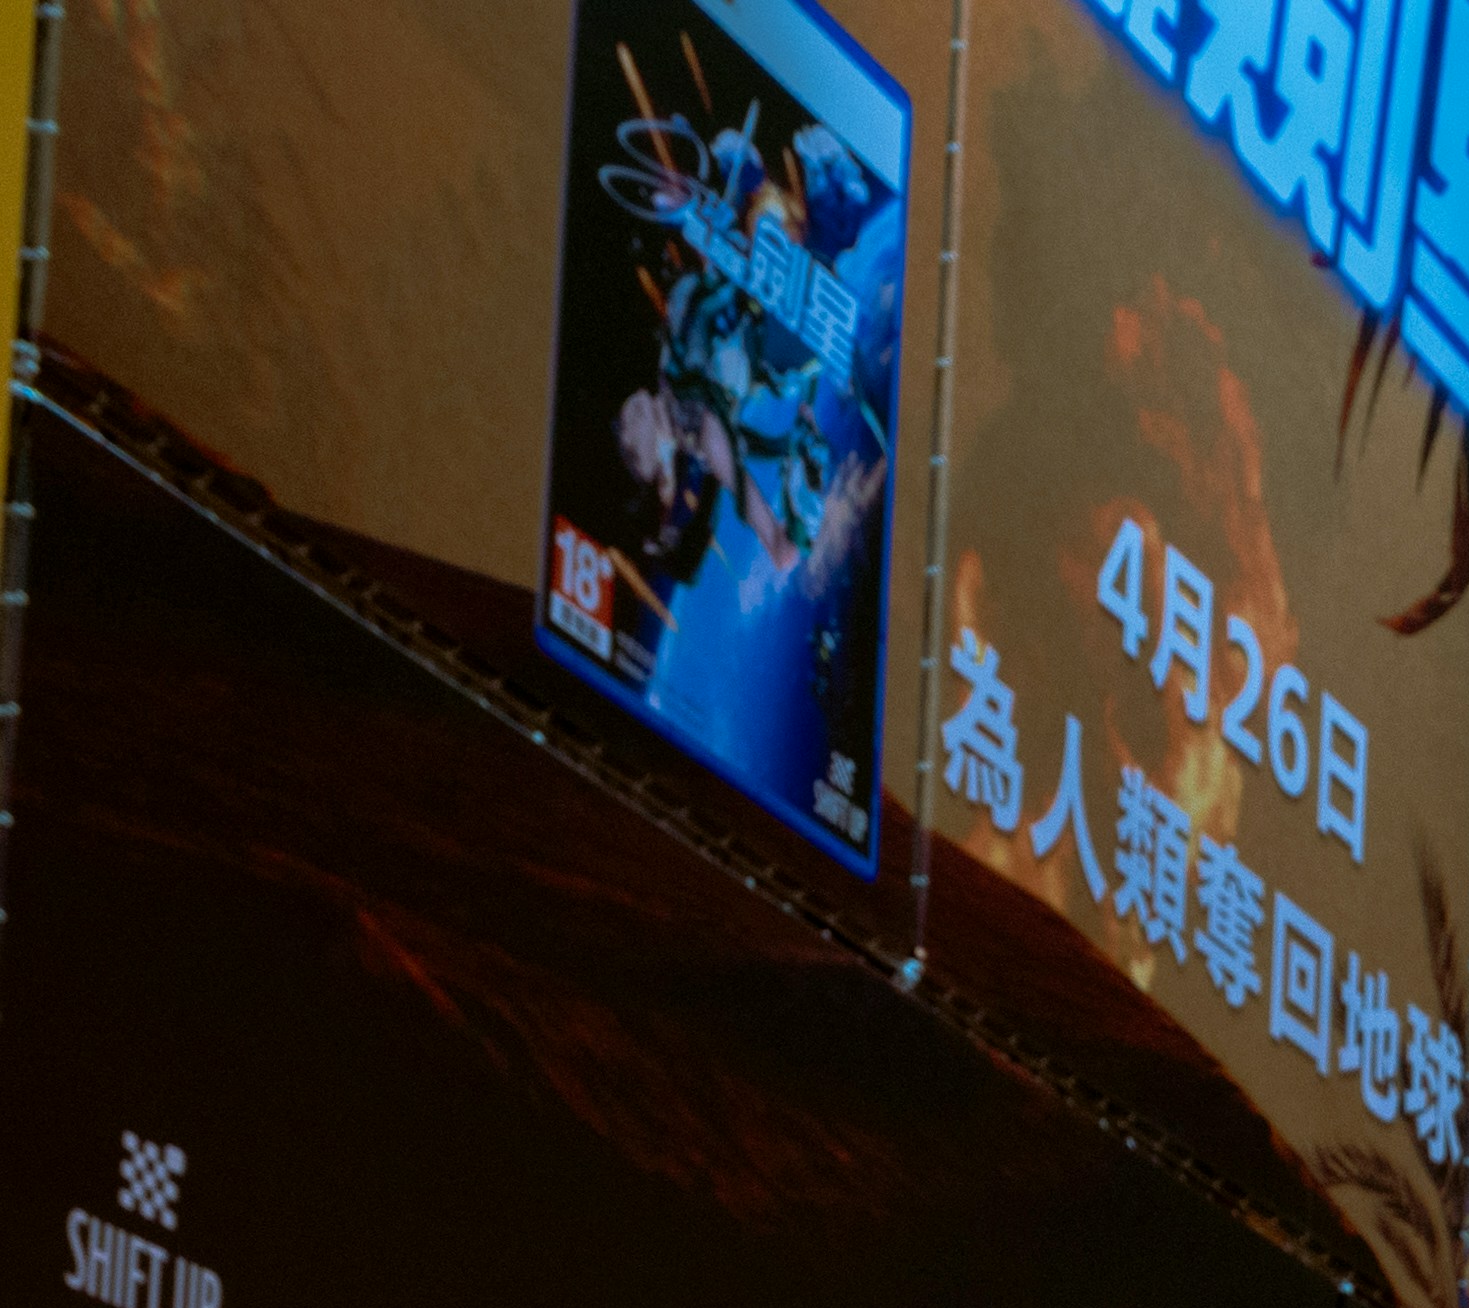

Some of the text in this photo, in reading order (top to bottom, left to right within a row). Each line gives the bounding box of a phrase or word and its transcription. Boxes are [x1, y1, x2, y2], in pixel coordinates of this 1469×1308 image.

[942, 625, 1464, 1165] 為人類奪回地球
[1097, 517, 1368, 865] 4月26日
